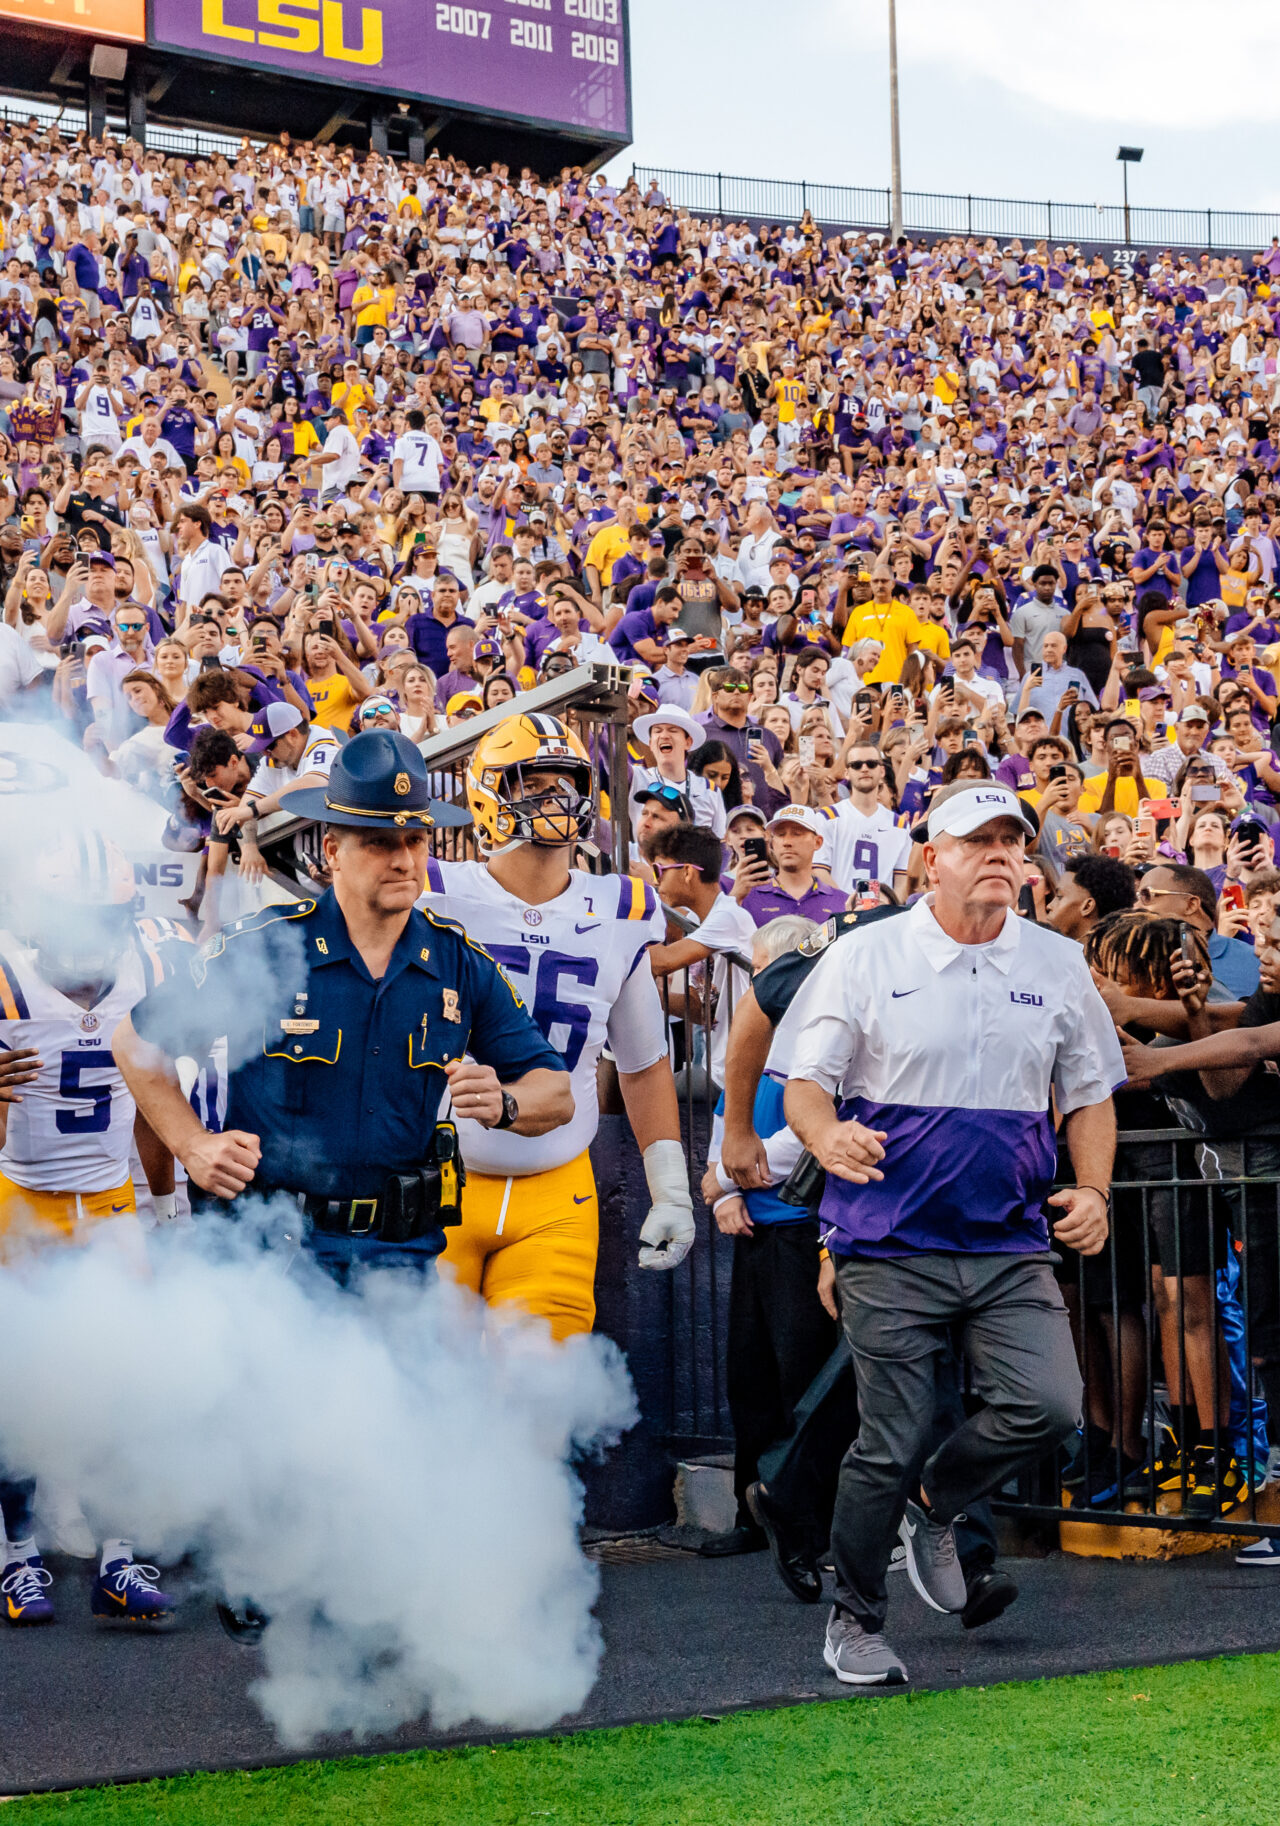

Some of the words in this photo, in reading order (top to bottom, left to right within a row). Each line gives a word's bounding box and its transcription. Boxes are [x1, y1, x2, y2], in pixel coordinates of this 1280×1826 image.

[435, 3, 490, 39] 2007
[202, 0, 383, 66] LSU
[510, 19, 552, 53] 2011
[571, 32, 618, 66] 2019
[1113, 250, 1138, 263] 237
[140, 306, 152, 320] 9
[251, 312, 273, 328] 24
[784, 386, 799, 402] 10
[96, 395, 110, 417] 9
[843, 398, 859, 414] 18
[870, 402, 884, 418] 10
[415, 443, 428, 467] 7
[313, 750, 326, 765] 9
[546, 746, 569, 755] LSU
[976, 795, 1007, 804] LSU
[853, 840, 878, 889] 9
[521, 933, 550, 944] LSU
[1010, 991, 1043, 1007] LSU
[78, 1038, 102, 1047] LSU
[56, 1050, 118, 1134] 5
